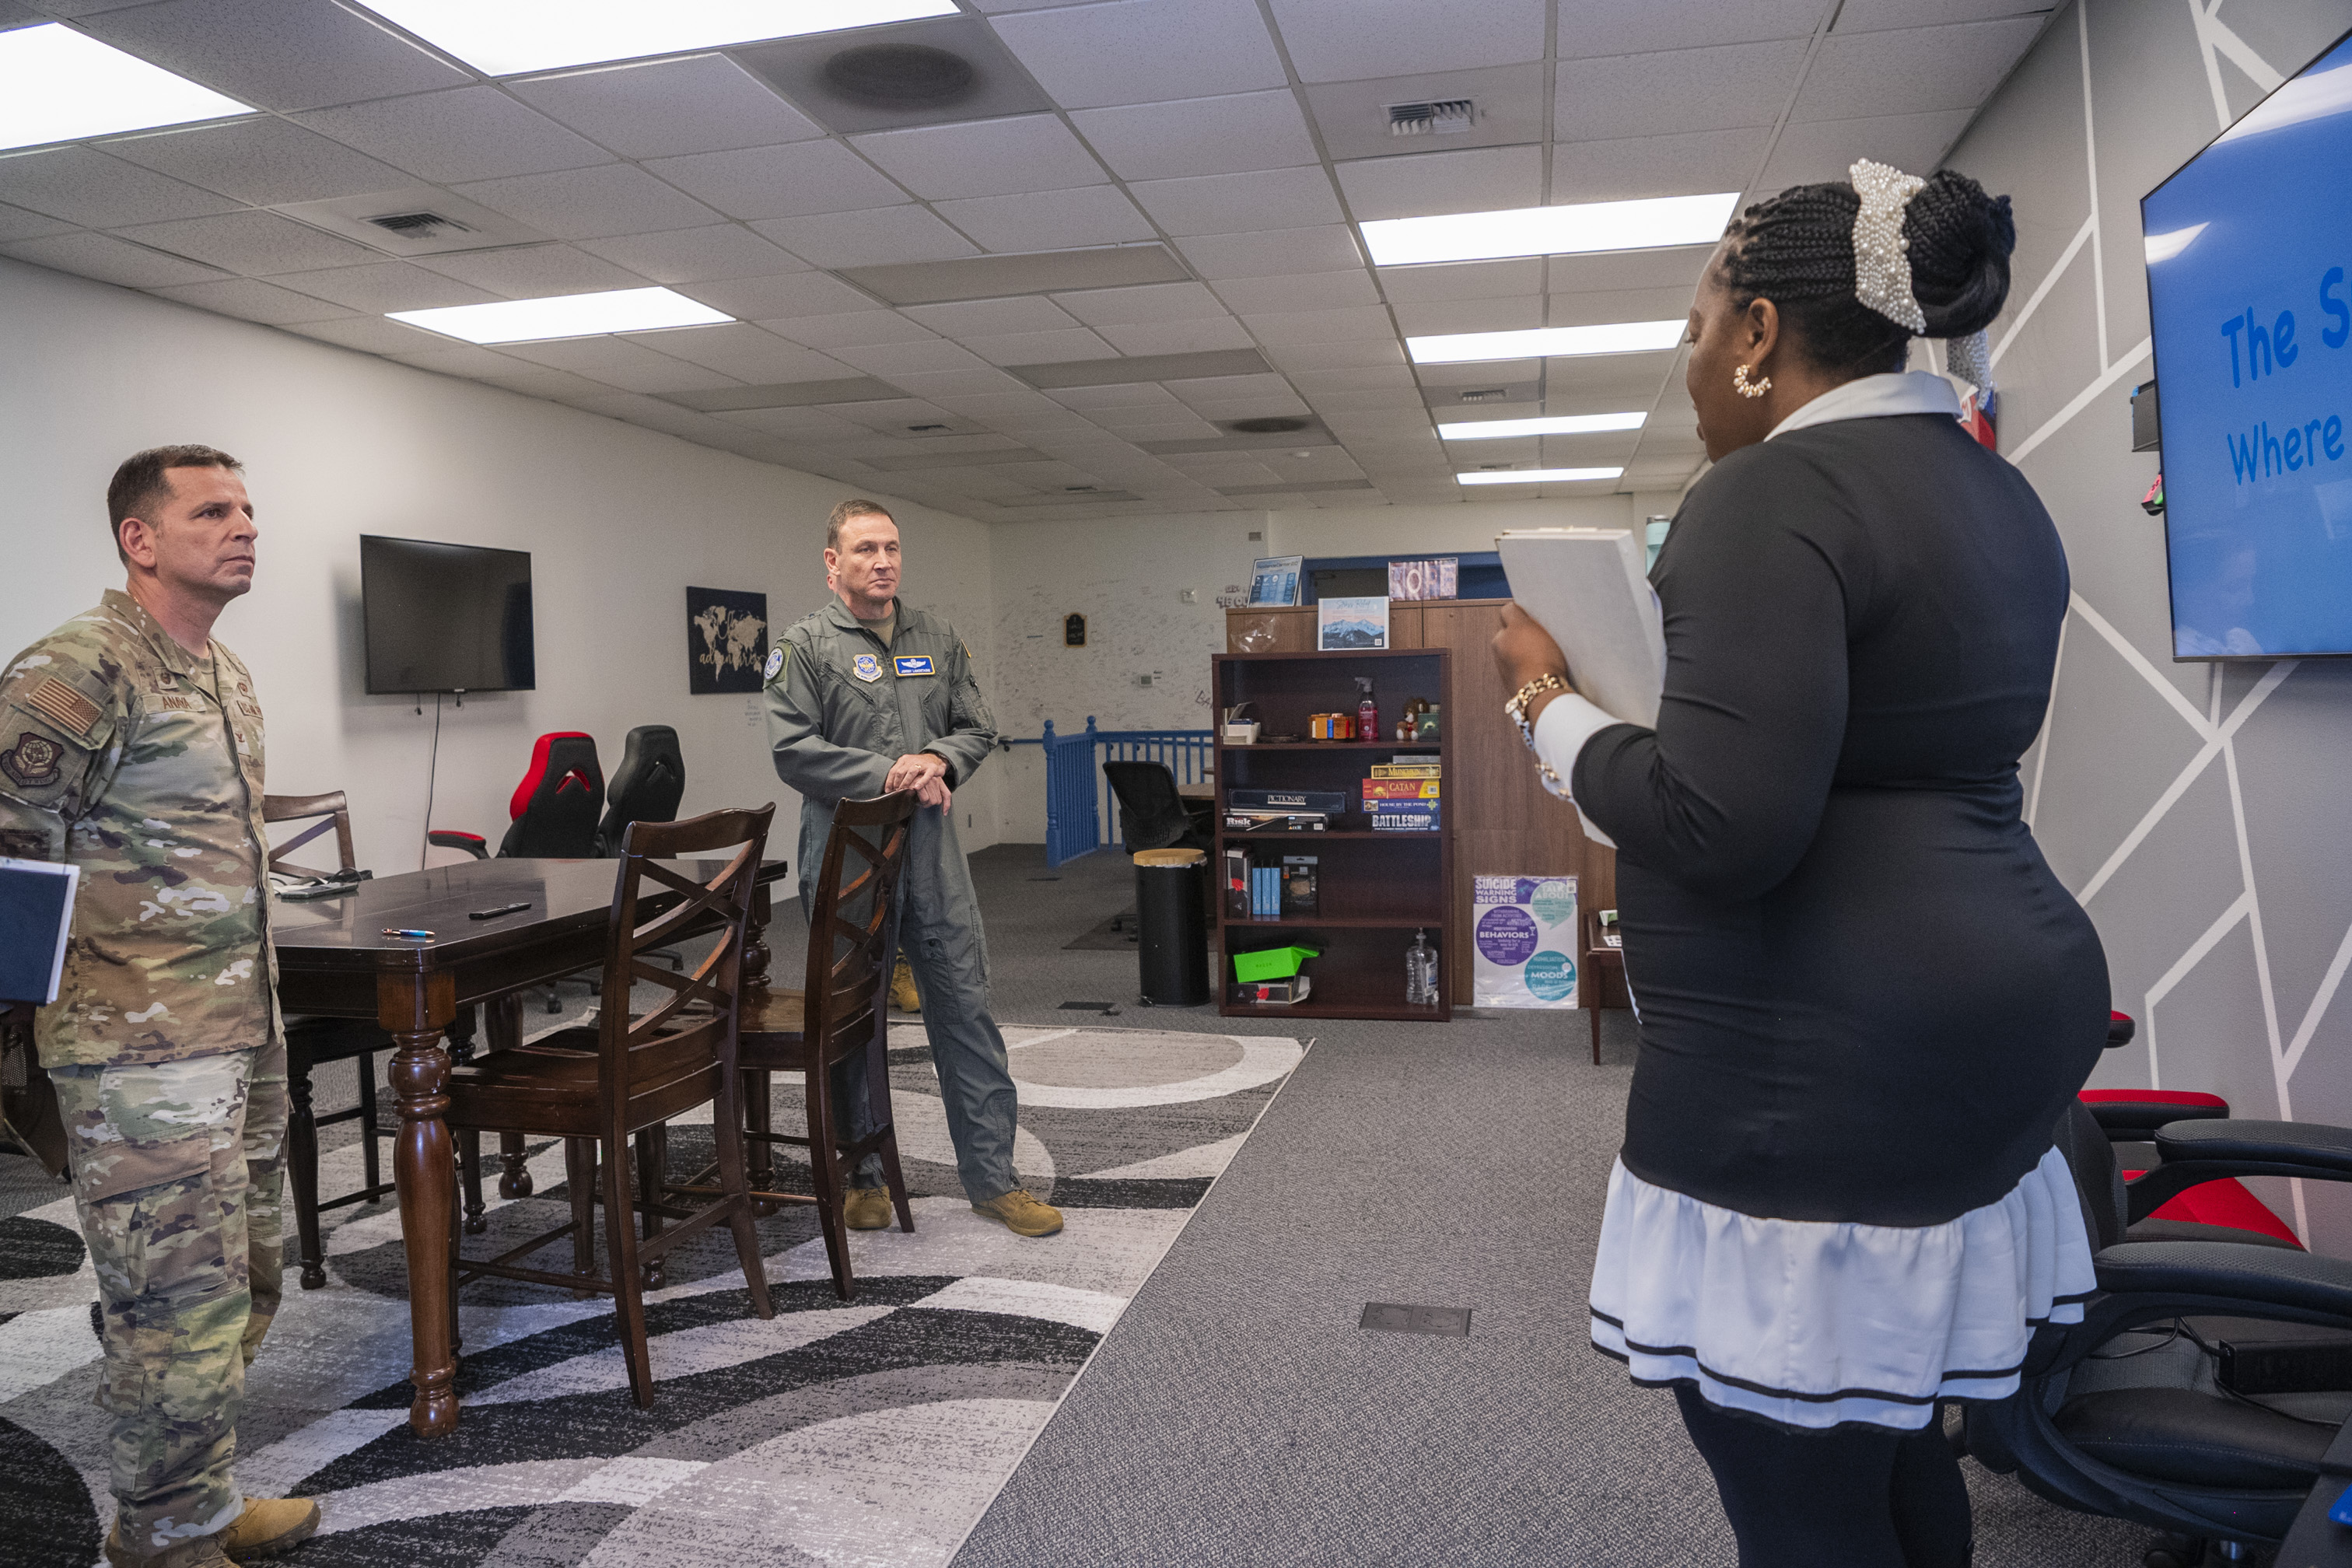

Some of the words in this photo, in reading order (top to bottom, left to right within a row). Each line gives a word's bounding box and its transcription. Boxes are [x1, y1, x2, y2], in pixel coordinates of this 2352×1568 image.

[2221, 306, 2298, 389] The
[2319, 267, 2352, 348] S
[2227, 415, 2344, 485] Where
[163, 696, 193, 709] ANAYA
[1389, 782, 1416, 792] CATAN
[1372, 814, 1432, 828] BATTLESHIP
[1475, 878, 1517, 890] SUICIDE
